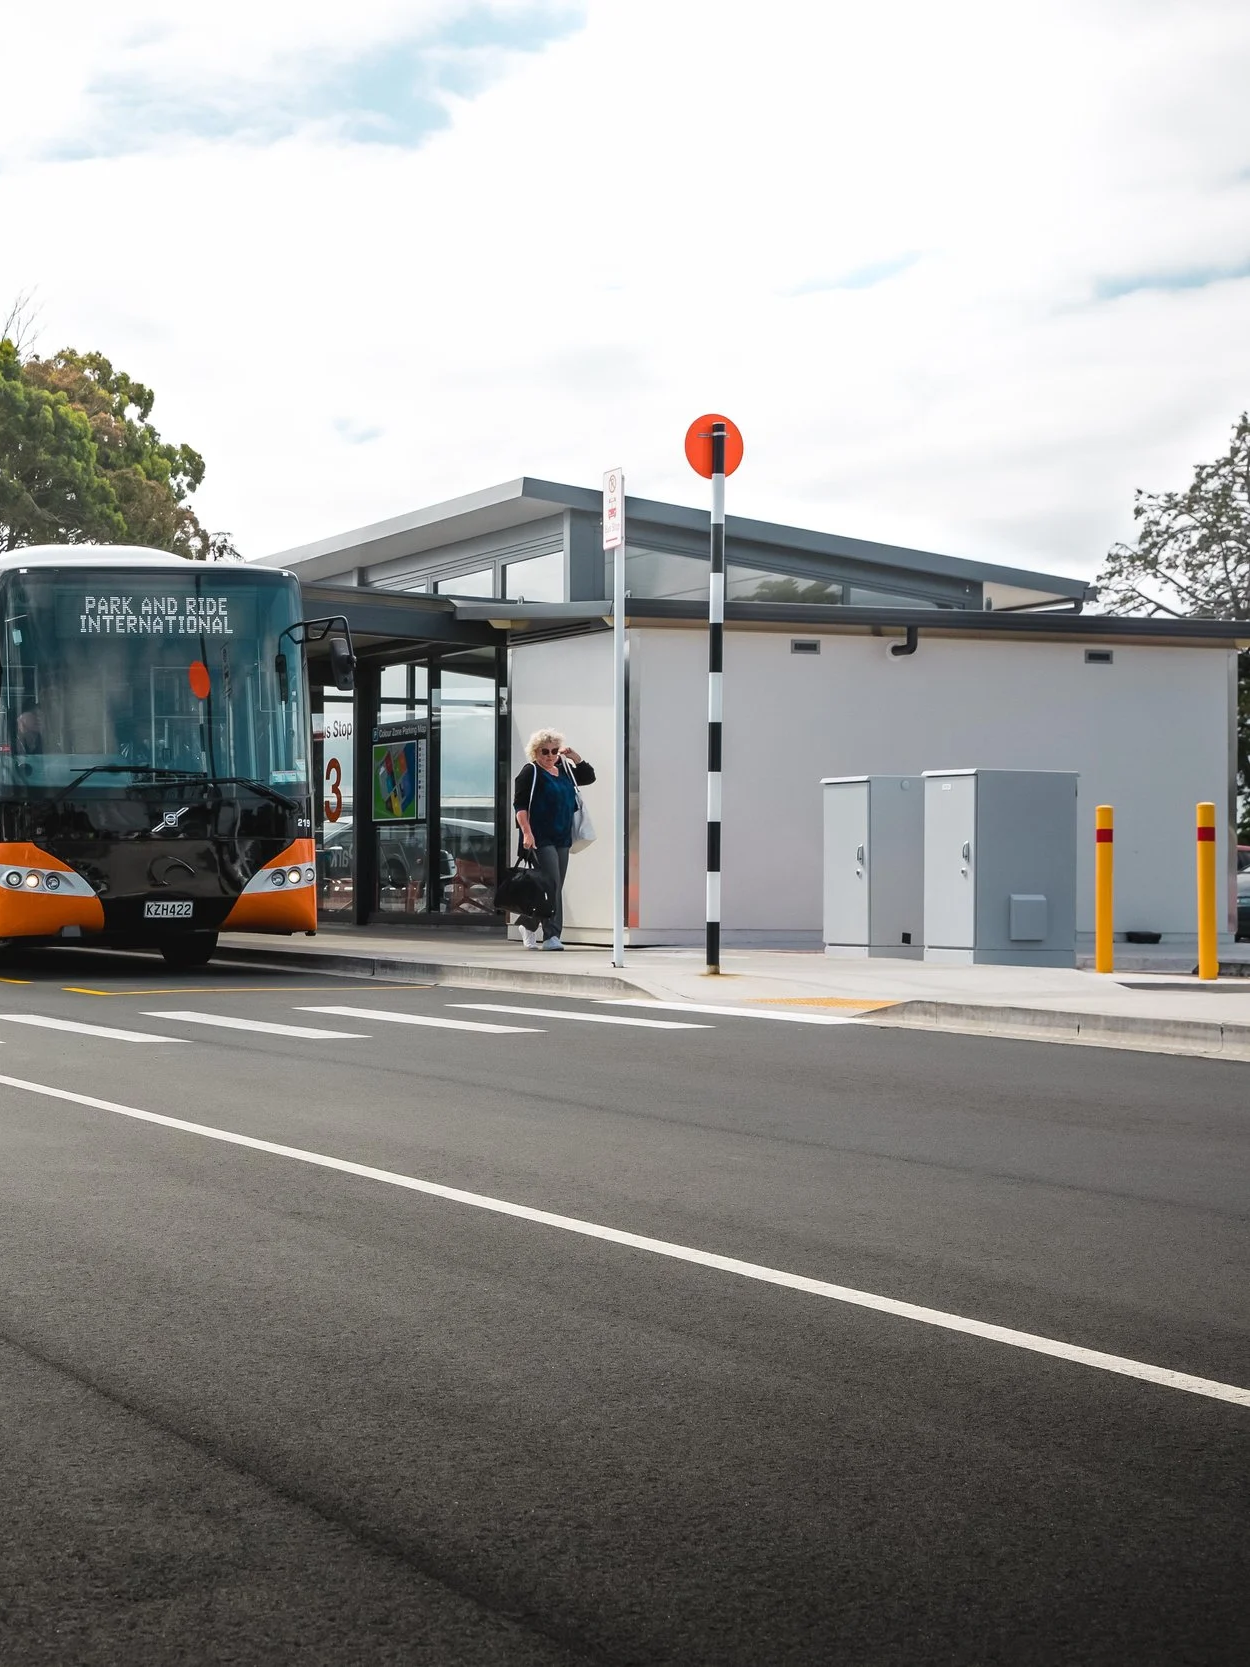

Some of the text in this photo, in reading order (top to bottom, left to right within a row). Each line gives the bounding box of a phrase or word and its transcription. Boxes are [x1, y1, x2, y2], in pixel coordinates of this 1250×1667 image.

[85, 596, 228, 616] PARK AND RIDE
[80, 615, 234, 634] INTERNATIONAL
[333, 720, 353, 740] Stop
[379, 729, 392, 738] Colour
[392, 727, 402, 737] Zone
[402, 725, 417, 736] Parking
[325, 758, 342, 823] 3
[297, 818, 311, 828] 219
[146, 904, 191, 916] KZH422
